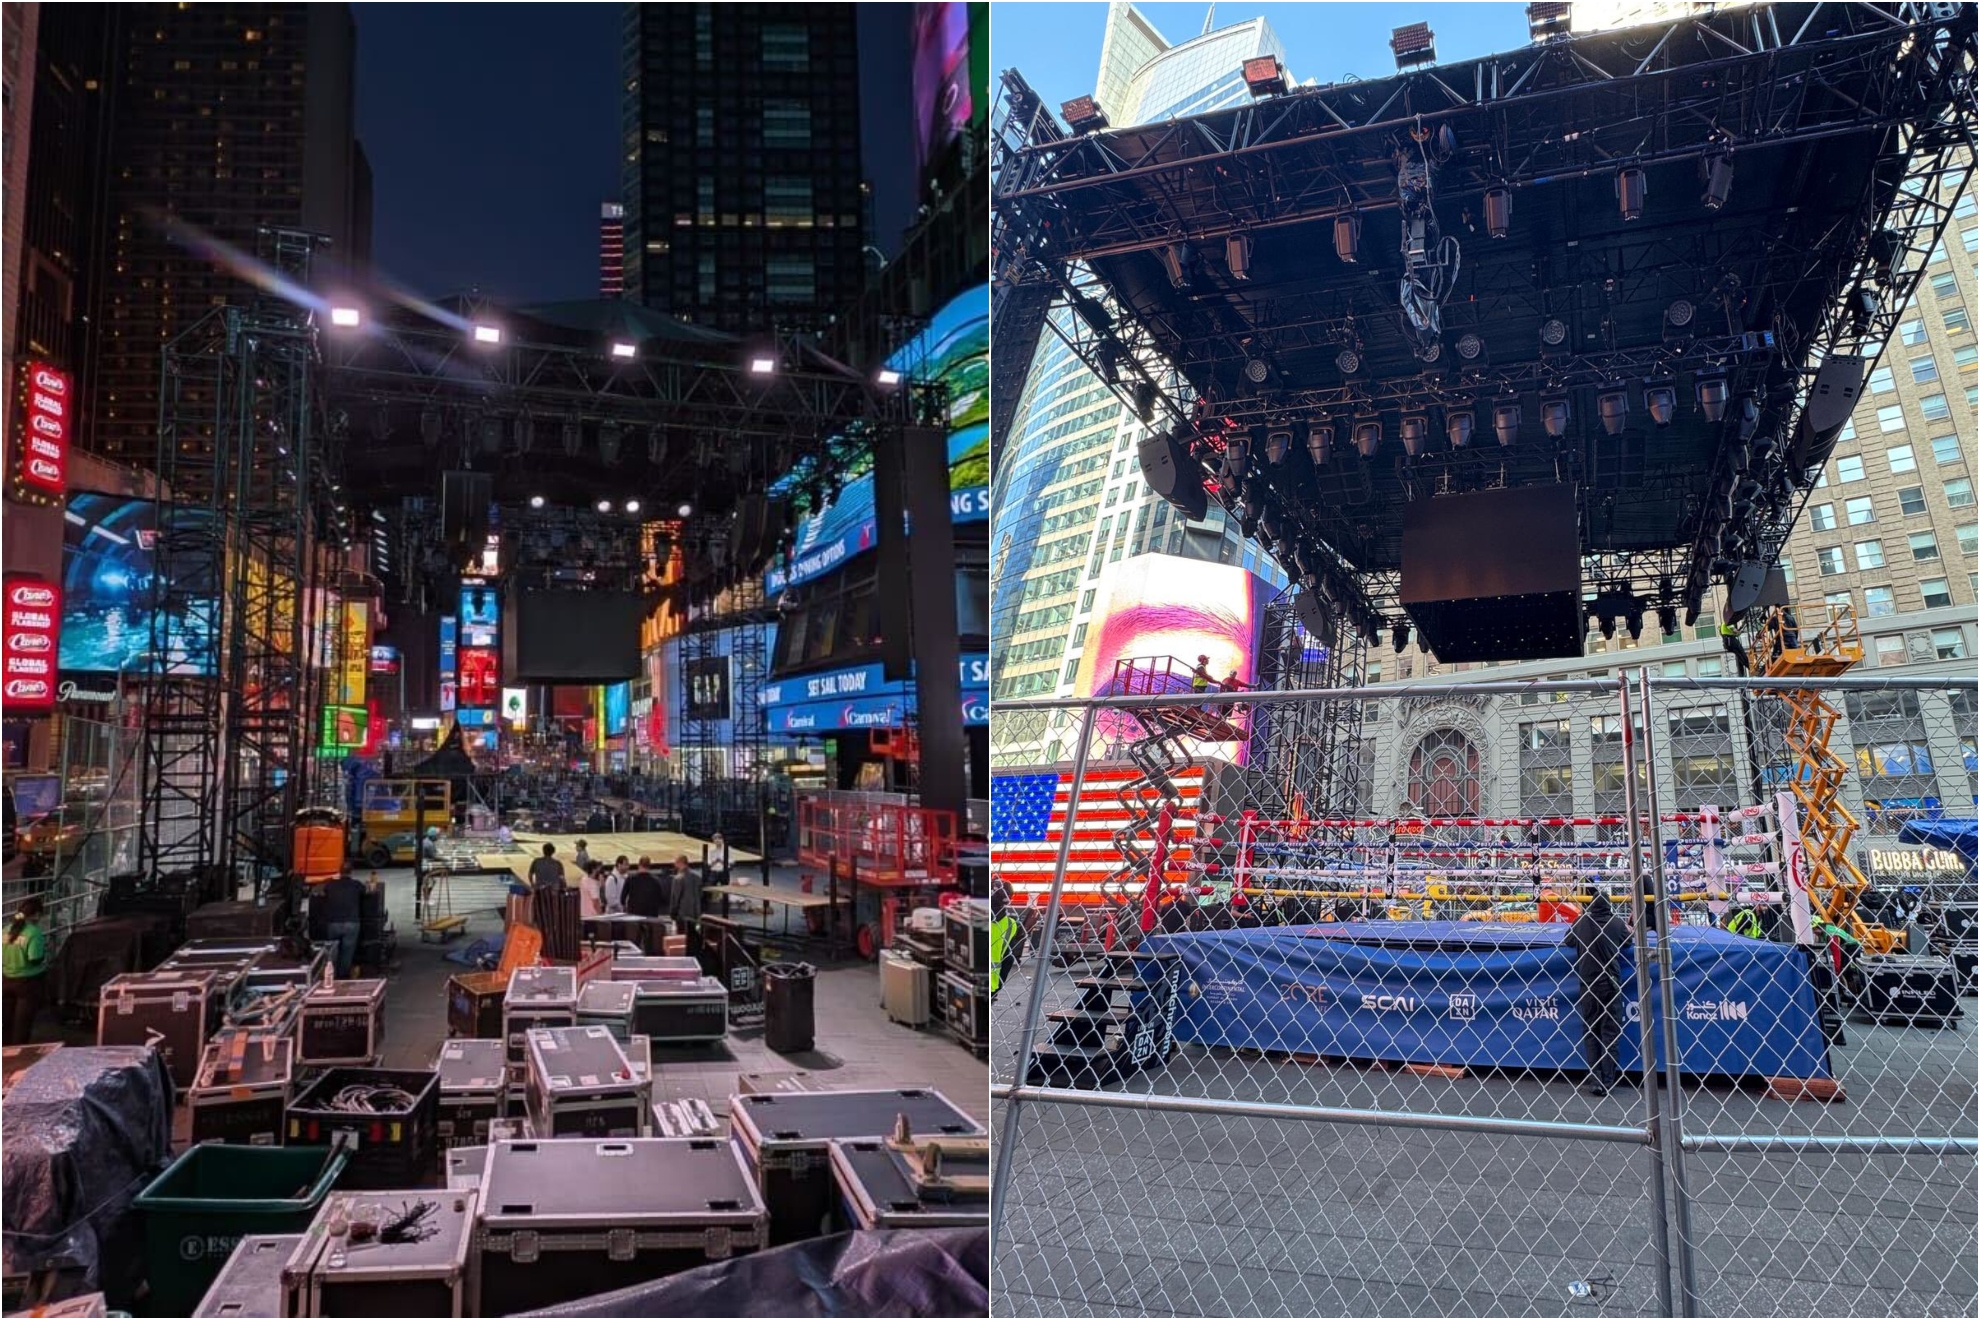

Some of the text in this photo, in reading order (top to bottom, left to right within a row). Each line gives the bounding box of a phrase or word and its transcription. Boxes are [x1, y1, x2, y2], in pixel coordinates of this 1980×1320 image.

[808, 671, 867, 697] SET SAIL TODAY
[1871, 849, 1924, 870] BUBBA
[1361, 994, 1414, 1011] SCAI
[1525, 995, 1558, 1007] visit
[1512, 1006, 1560, 1020] QATAR
